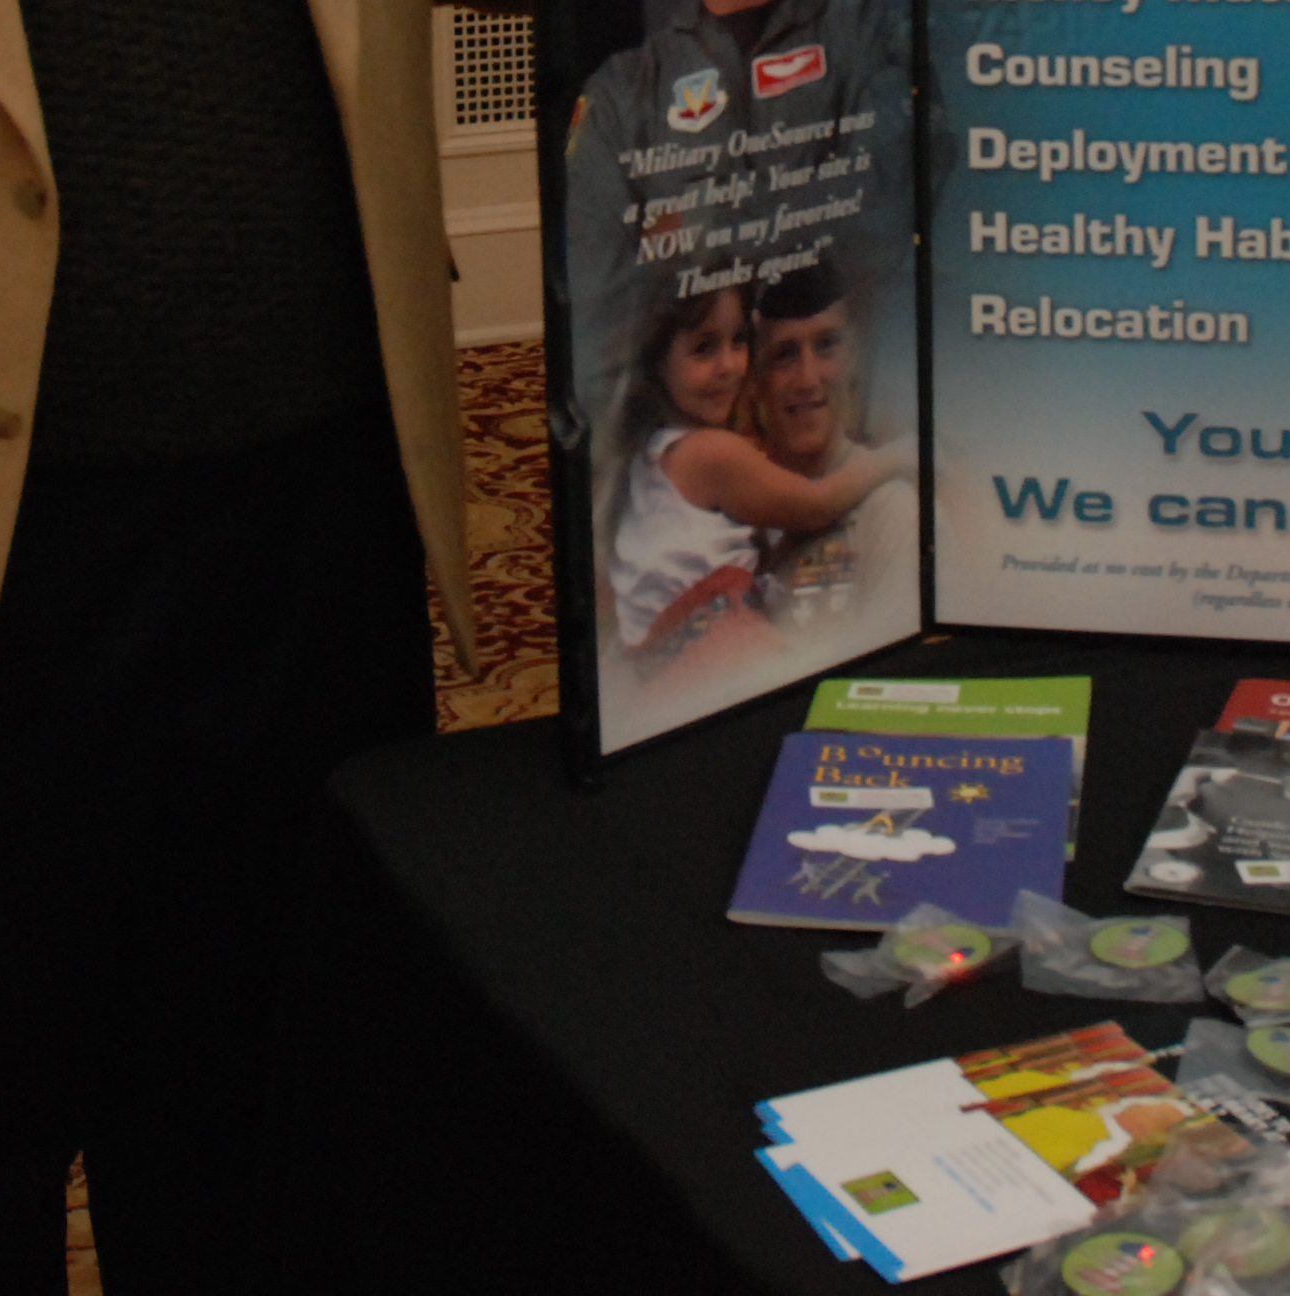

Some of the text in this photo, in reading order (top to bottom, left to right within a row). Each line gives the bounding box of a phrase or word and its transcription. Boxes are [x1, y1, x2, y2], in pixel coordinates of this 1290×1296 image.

[965, 42, 1260, 101] Counseling
[728, 120, 835, 158] OneSource
[968, 126, 1288, 184] Deployment
[623, 146, 871, 229] a great help! Your site is
[636, 223, 703, 266] NOW
[706, 227, 733, 248] on
[738, 219, 770, 247] my
[969, 211, 1175, 269] Healthy
[677, 256, 754, 299] Thanks
[970, 294, 1250, 344] Relocation
[993, 476, 1113, 522] We
[1149, 494, 1287, 531] can
[1002, 554, 1076, 574] Provided
[1168, 562, 1189, 582] by
[1194, 563, 1220, 580] the
[814, 765, 912, 788] Back
[820, 743, 1025, 775] Bouncing
